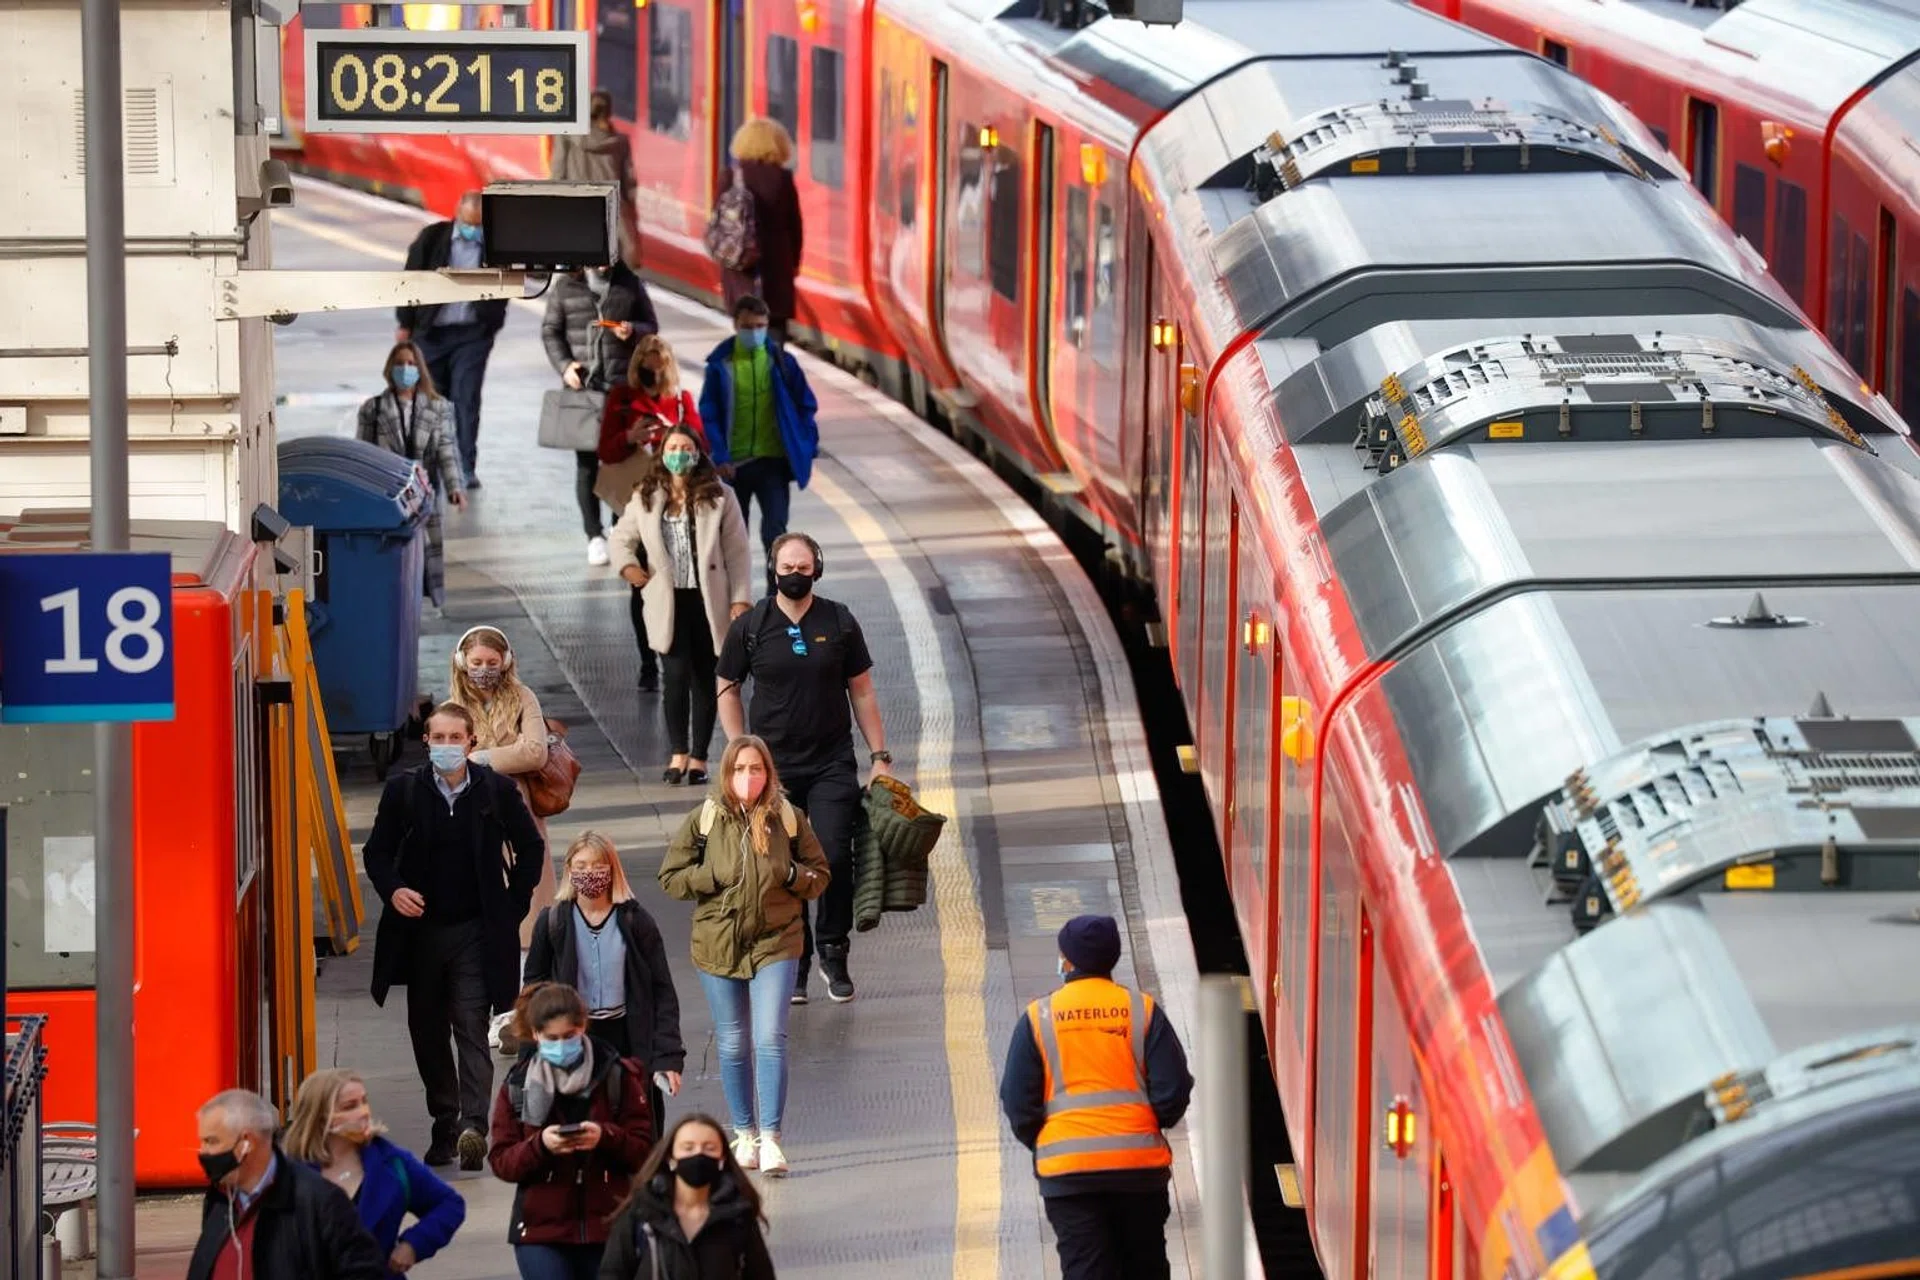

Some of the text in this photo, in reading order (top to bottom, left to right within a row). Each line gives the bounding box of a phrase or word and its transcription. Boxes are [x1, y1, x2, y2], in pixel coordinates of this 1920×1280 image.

[331, 54, 564, 112] 08:21 18
[40, 586, 165, 674] 18
[1053, 1007, 1129, 1021] WATERLOO
